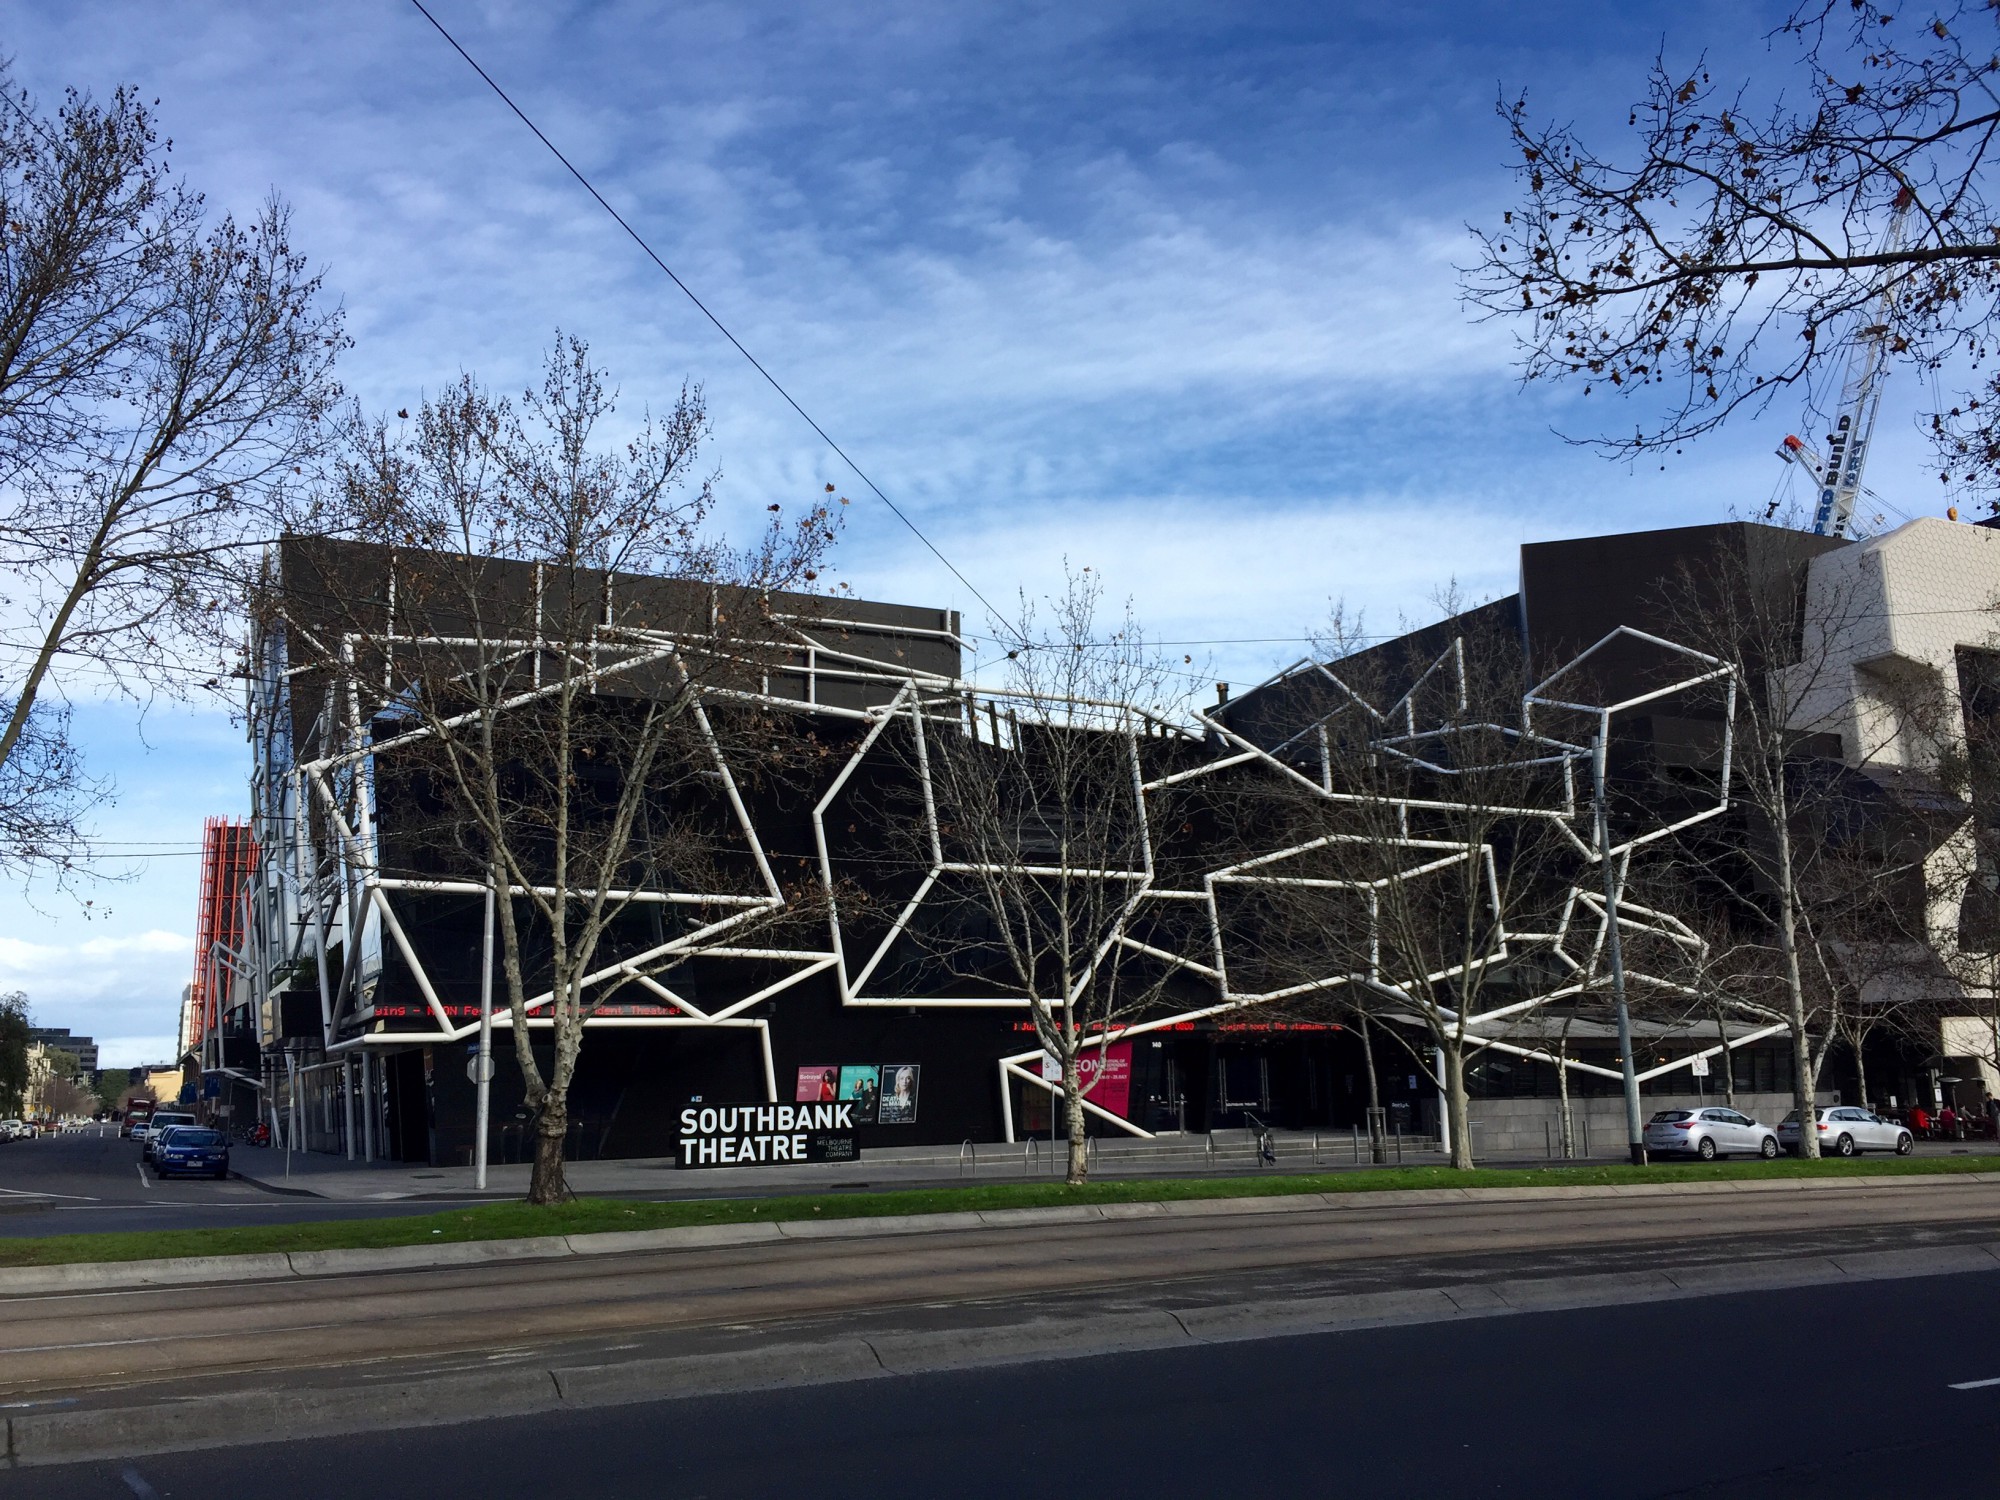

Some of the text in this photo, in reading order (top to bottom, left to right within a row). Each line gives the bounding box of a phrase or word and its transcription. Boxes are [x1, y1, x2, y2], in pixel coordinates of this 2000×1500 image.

[427, 1006, 457, 1016] NON
[680, 1104, 853, 1134] SOUTHBANK
[680, 1134, 808, 1164] THEATRE
[816, 1138, 853, 1146] MELBOURNE
